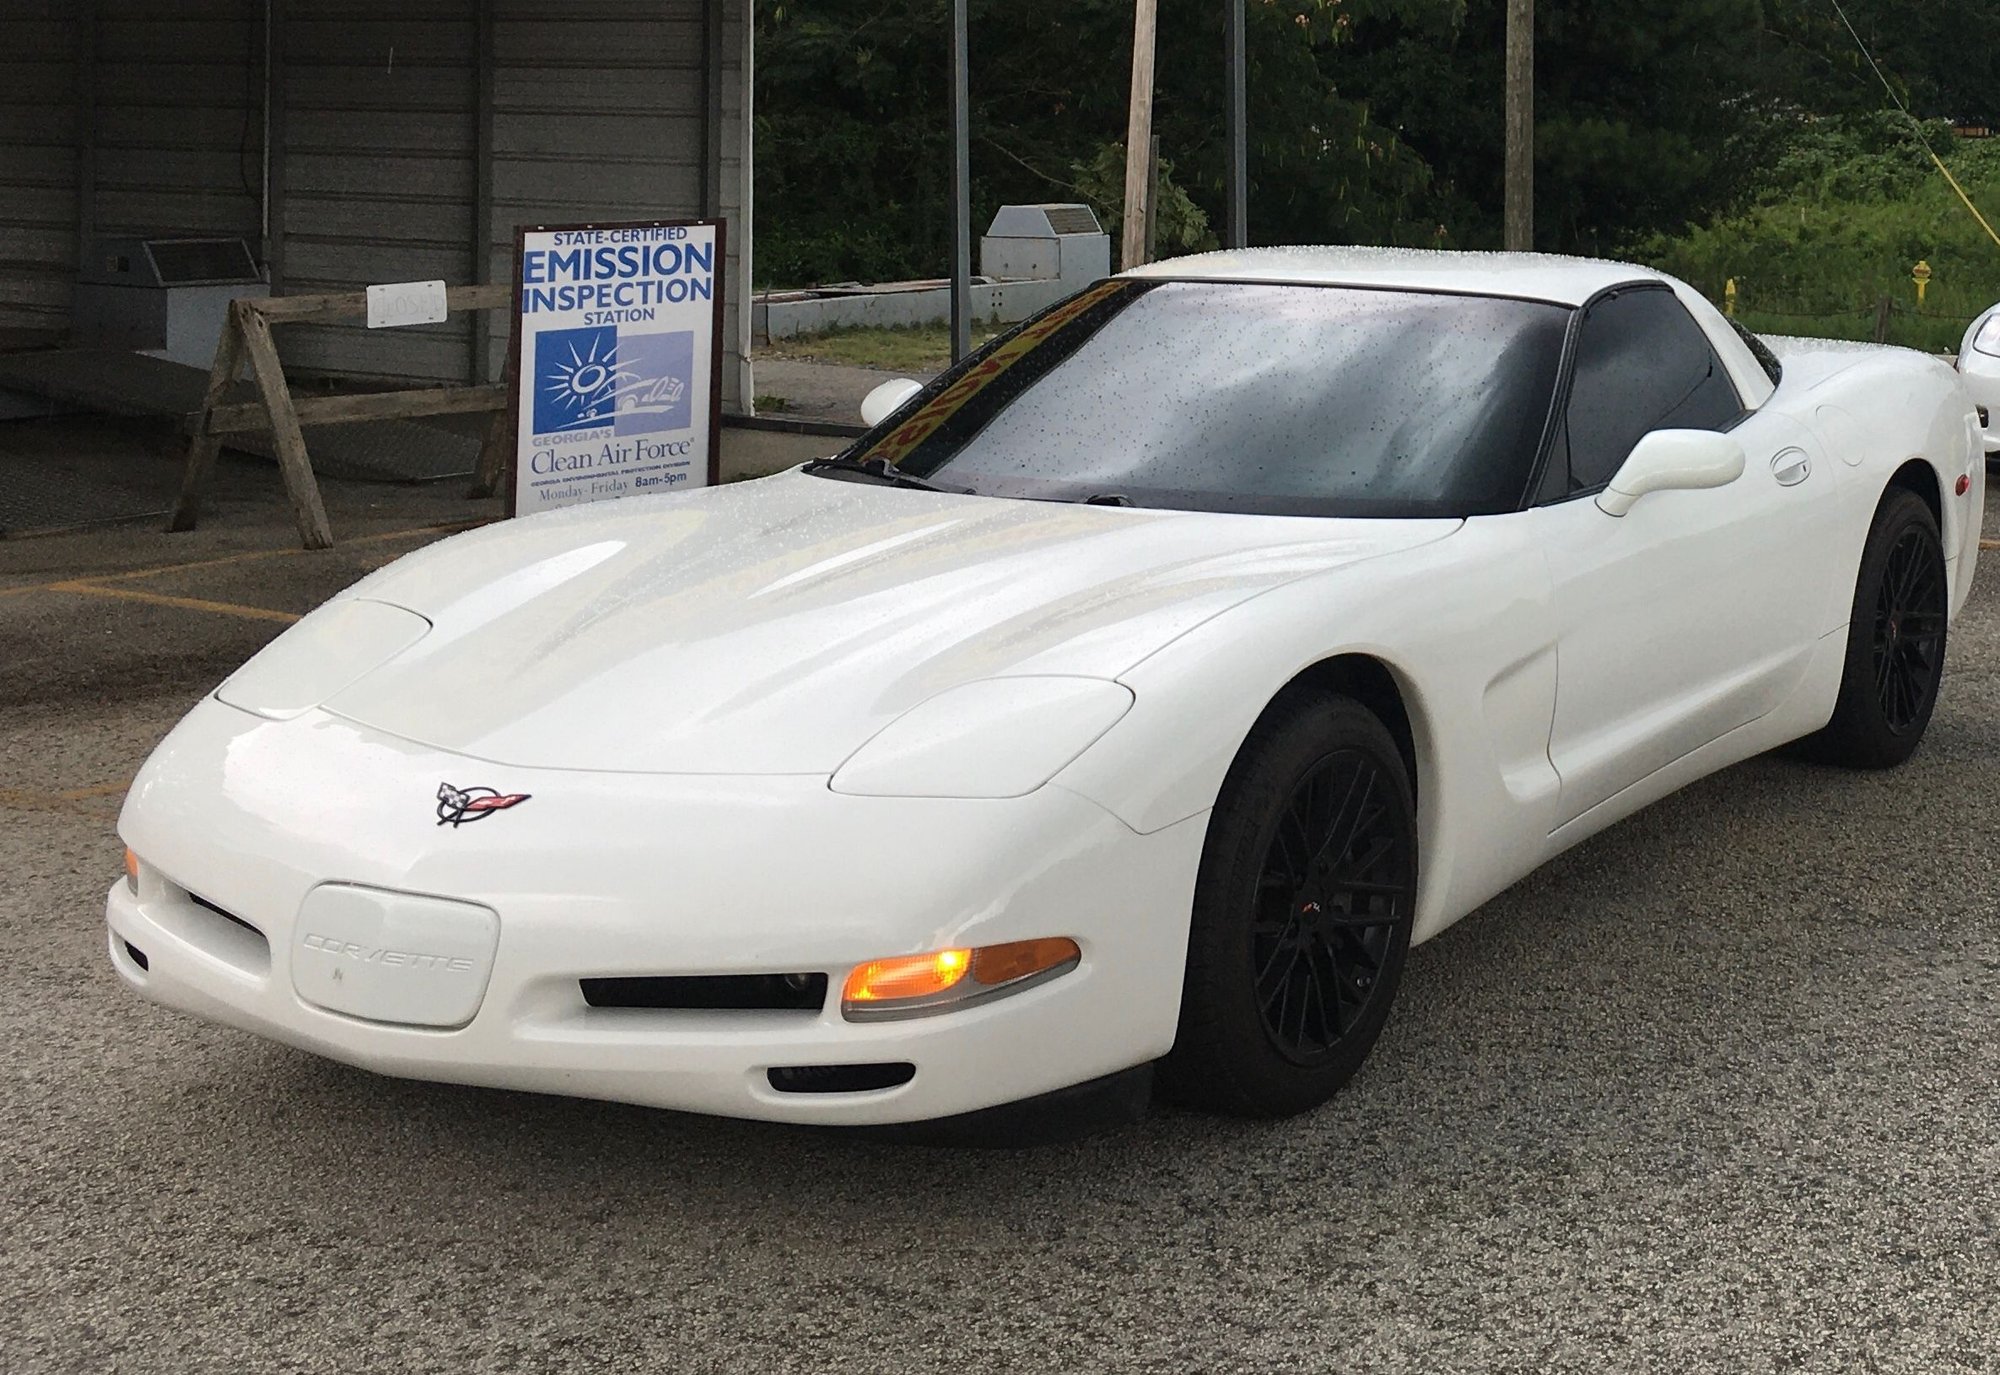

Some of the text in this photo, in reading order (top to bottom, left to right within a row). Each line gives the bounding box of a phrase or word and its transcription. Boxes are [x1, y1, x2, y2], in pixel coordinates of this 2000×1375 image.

[554, 227, 688, 246] STATE-CERTIFIED
[523, 242, 713, 284] EMISSION
[522, 277, 712, 314] INSPECTION
[584, 307, 655, 326] STATION
[532, 429, 612, 447] GEORGIA'S
[531, 449, 592, 475] Clean
[597, 443, 632, 466] Air
[591, 479, 628, 495] Friday
[635, 471, 687, 488] 8am-5pm
[303, 932, 474, 972] CORVETTE
